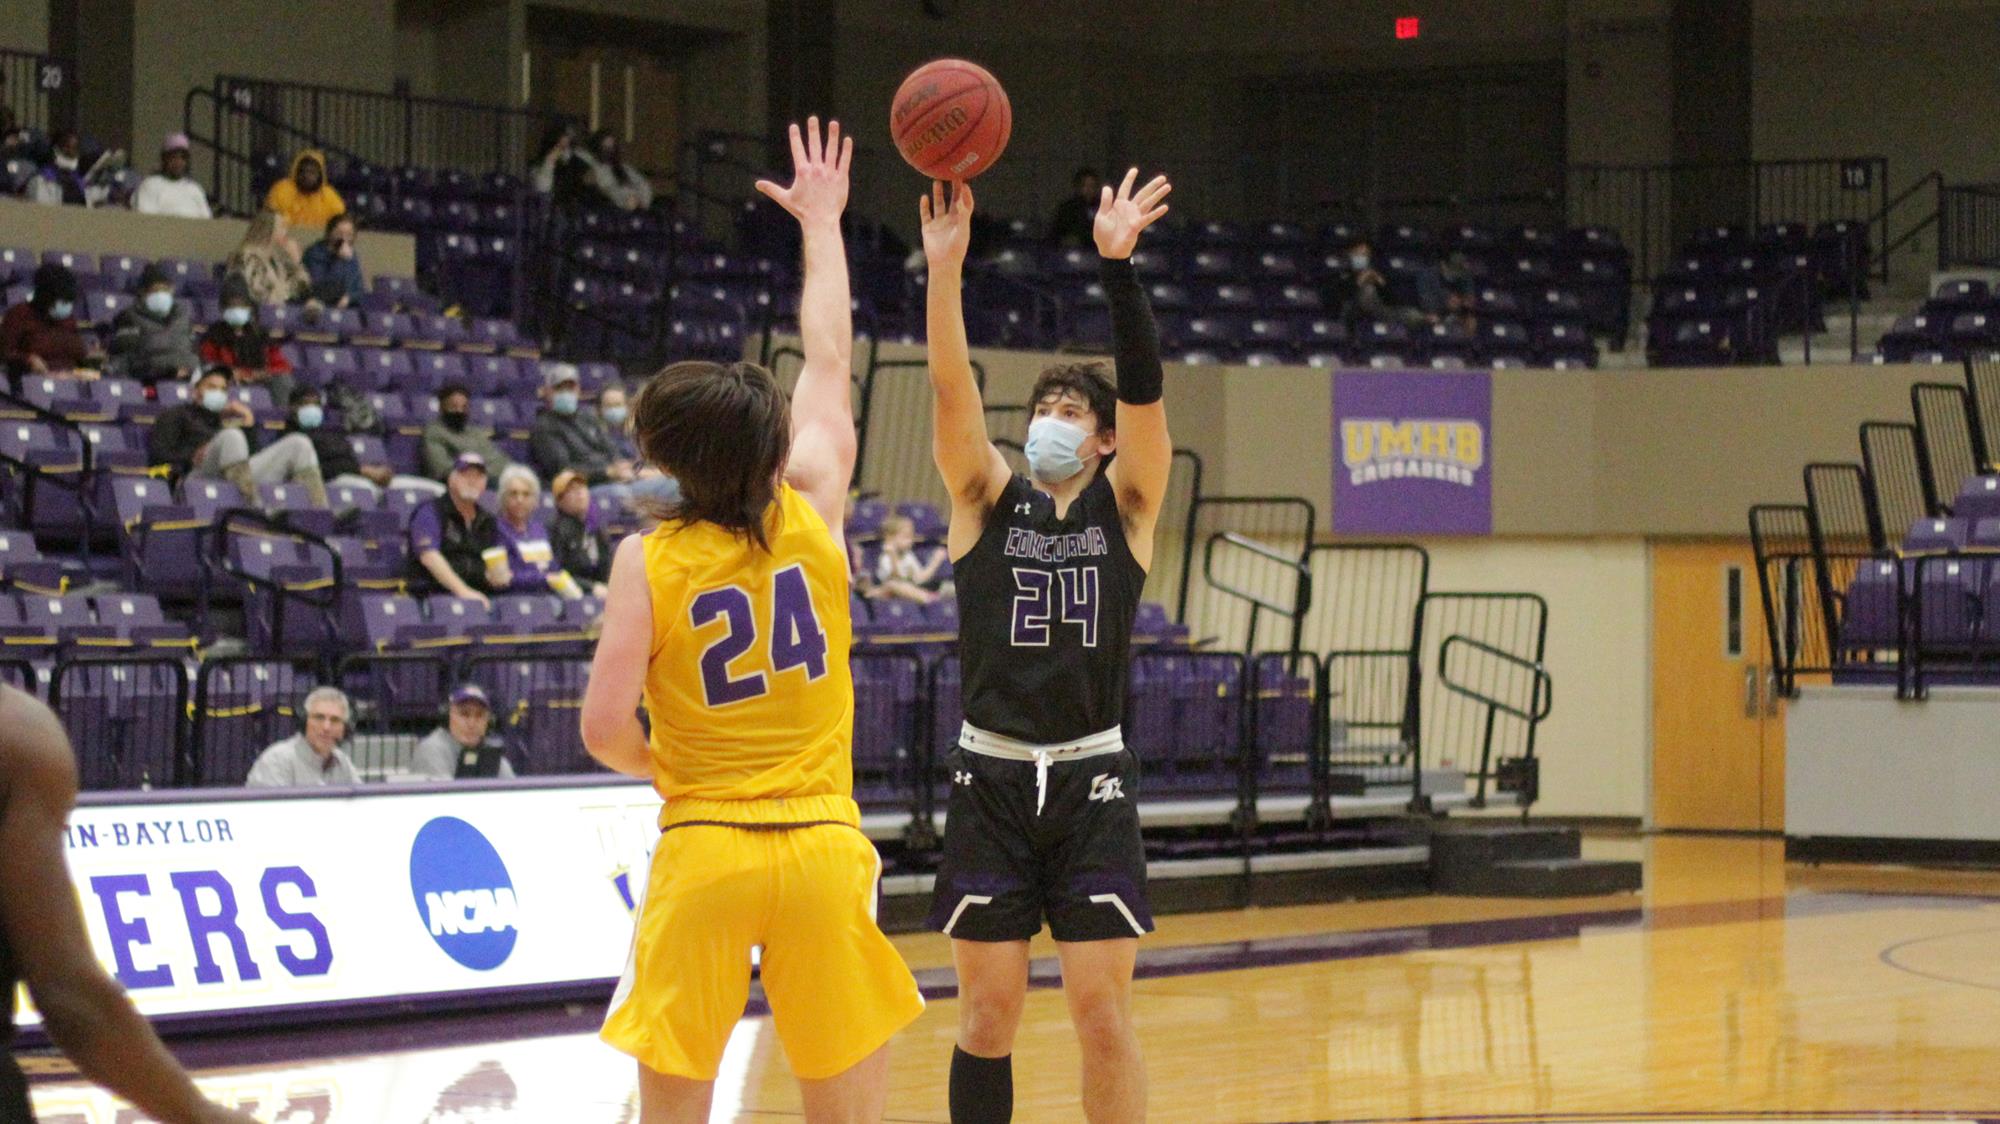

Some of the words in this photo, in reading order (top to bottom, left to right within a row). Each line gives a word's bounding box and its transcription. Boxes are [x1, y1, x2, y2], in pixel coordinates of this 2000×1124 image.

[42, 65, 61, 88] 20
[1342, 420, 1482, 469] UMHB
[1351, 459, 1473, 486] CRUSADERS
[1004, 527, 1107, 562] CONCORDIA
[1011, 566, 1099, 648] 24
[688, 562, 829, 709] 24
[90, 866, 334, 990] ERS
[425, 887, 519, 937] NCAA
